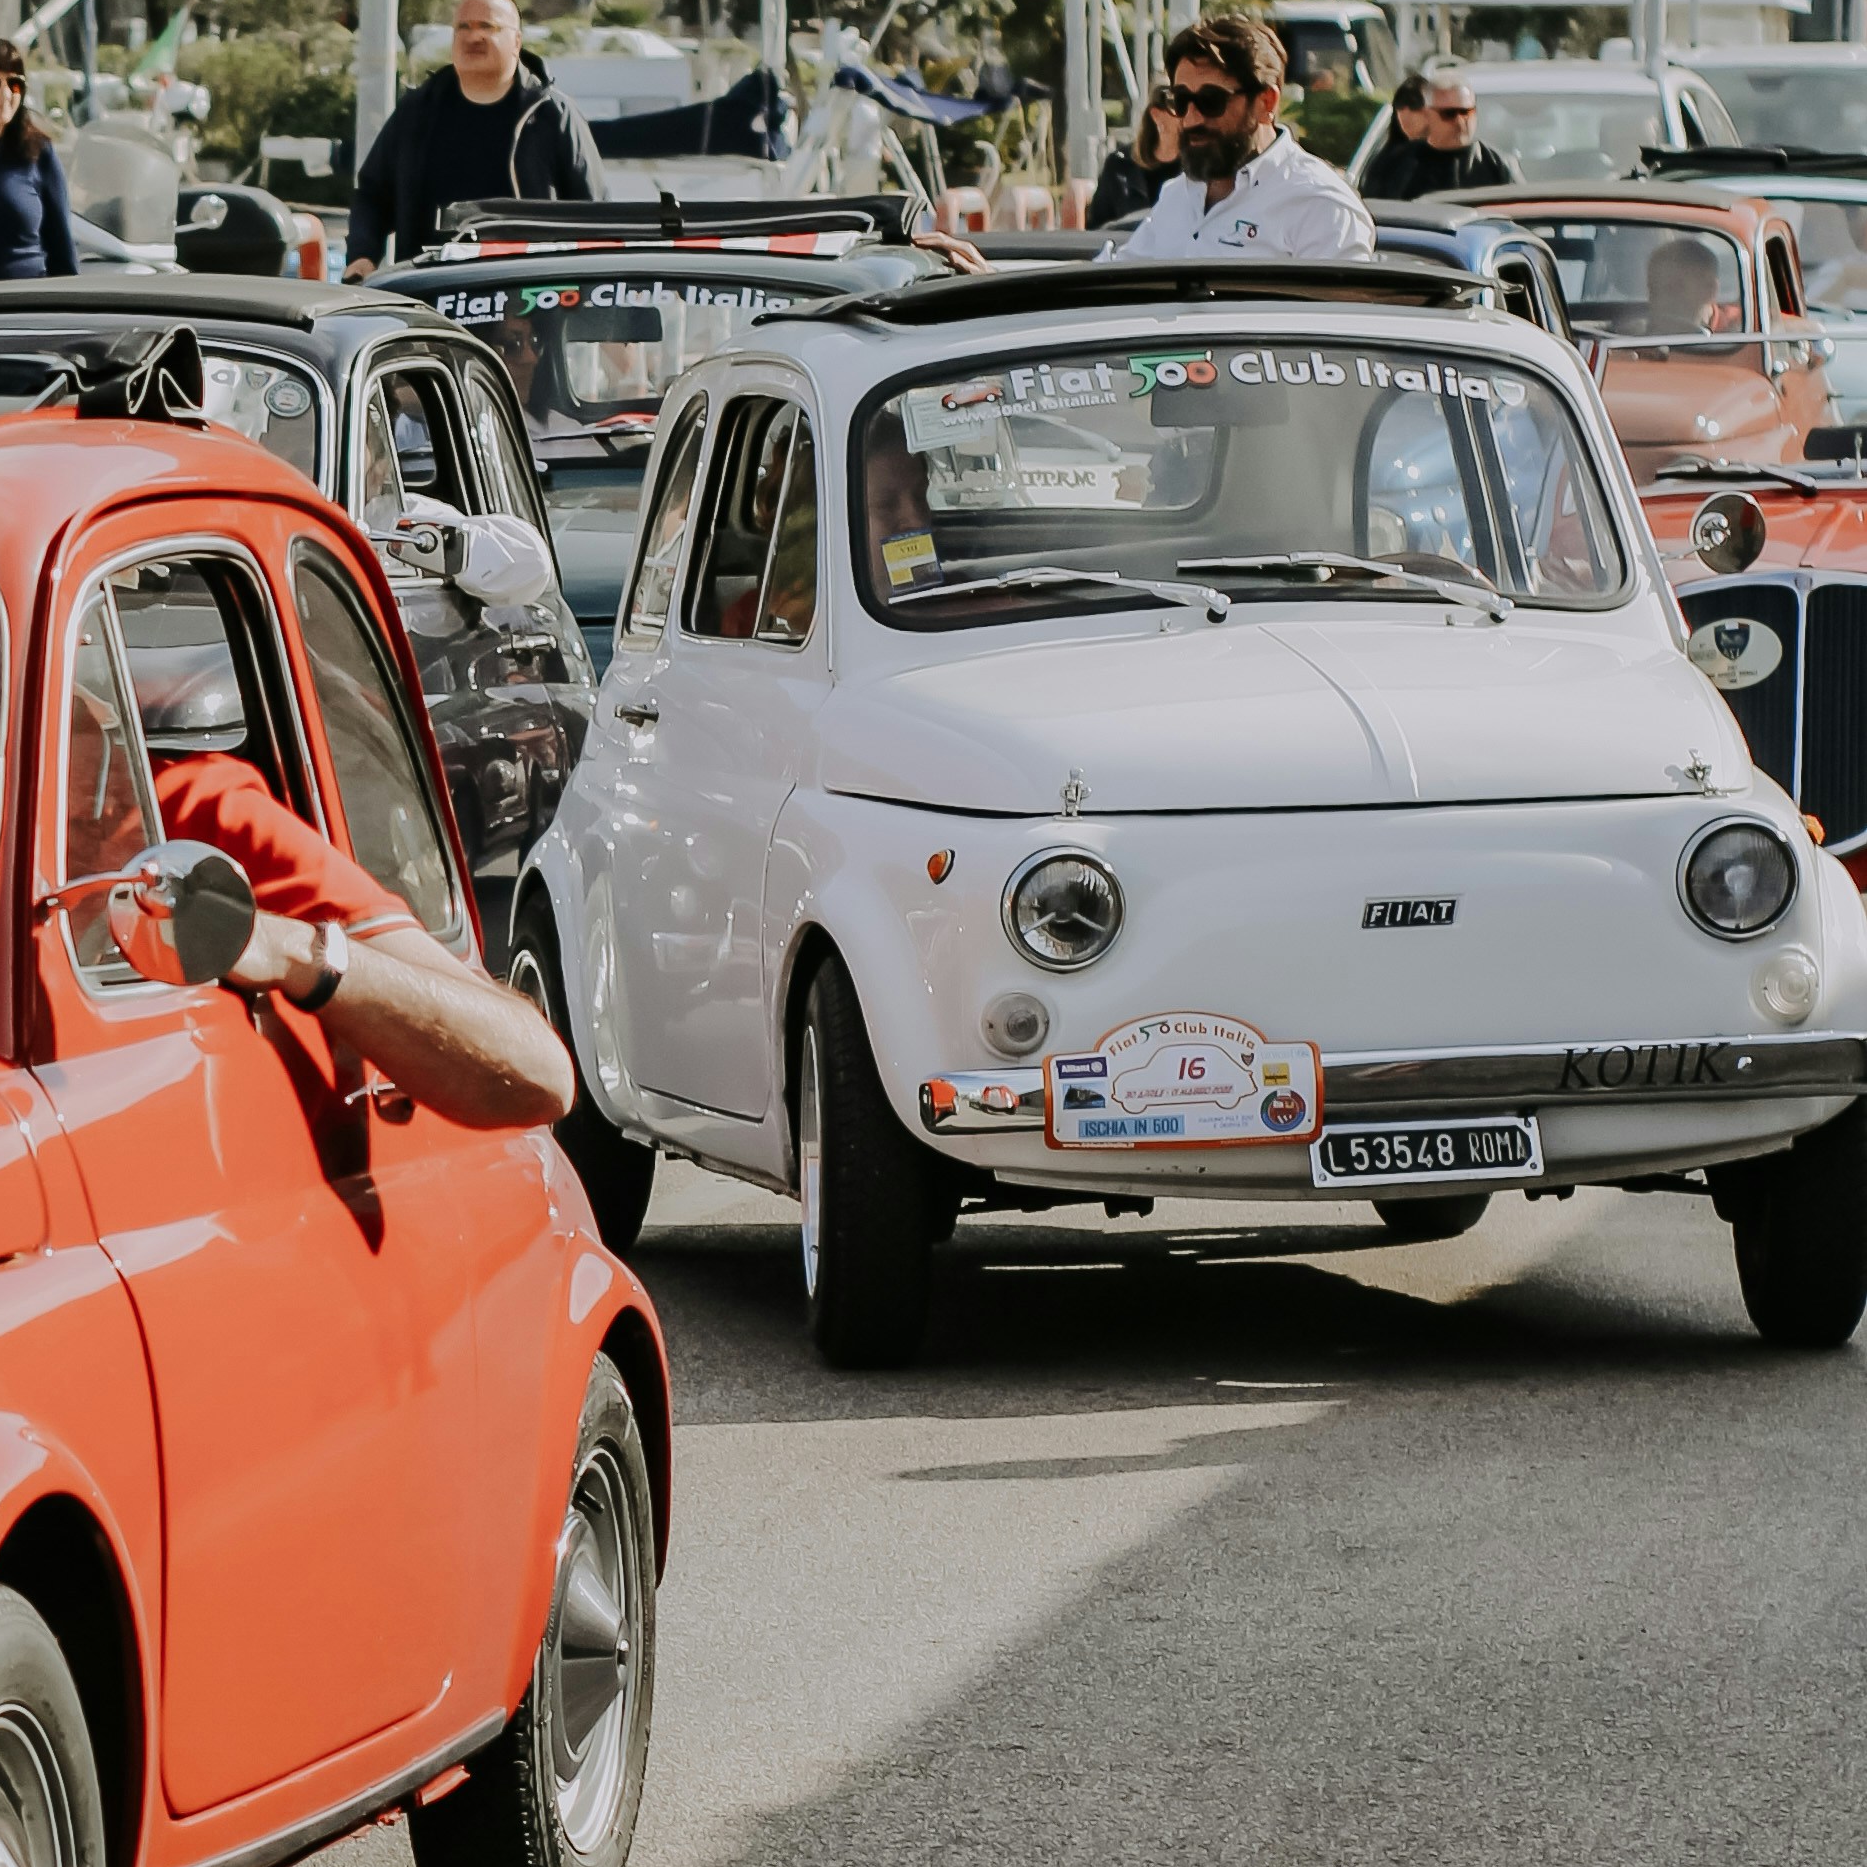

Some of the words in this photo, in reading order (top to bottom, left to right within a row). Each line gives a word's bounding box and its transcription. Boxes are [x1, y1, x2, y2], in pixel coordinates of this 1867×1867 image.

[436, 291, 509, 317] Fiat
[517, 285, 580, 316] 500
[590, 281, 678, 308] Club
[685, 285, 792, 314] Italia
[1008, 361, 1114, 401] Fiat
[1127, 350, 1219, 398] 500
[1229, 349, 1347, 386] Club
[1355, 356, 1491, 401] Italia
[1369, 901, 1453, 926] FIAT
[1108, 1033, 1137, 1057] Fiat
[1174, 1021, 1208, 1034] Club
[1214, 1025, 1256, 1050] Italia
[1178, 1057, 1206, 1081] 16
[1557, 1042, 1732, 1090] KOTIK
[1084, 1120, 1127, 1136] ISCHIA
[1134, 1119, 1147, 1134] IN
[1328, 1133, 1455, 1174] L53548
[1468, 1131, 1527, 1164] ROMA
